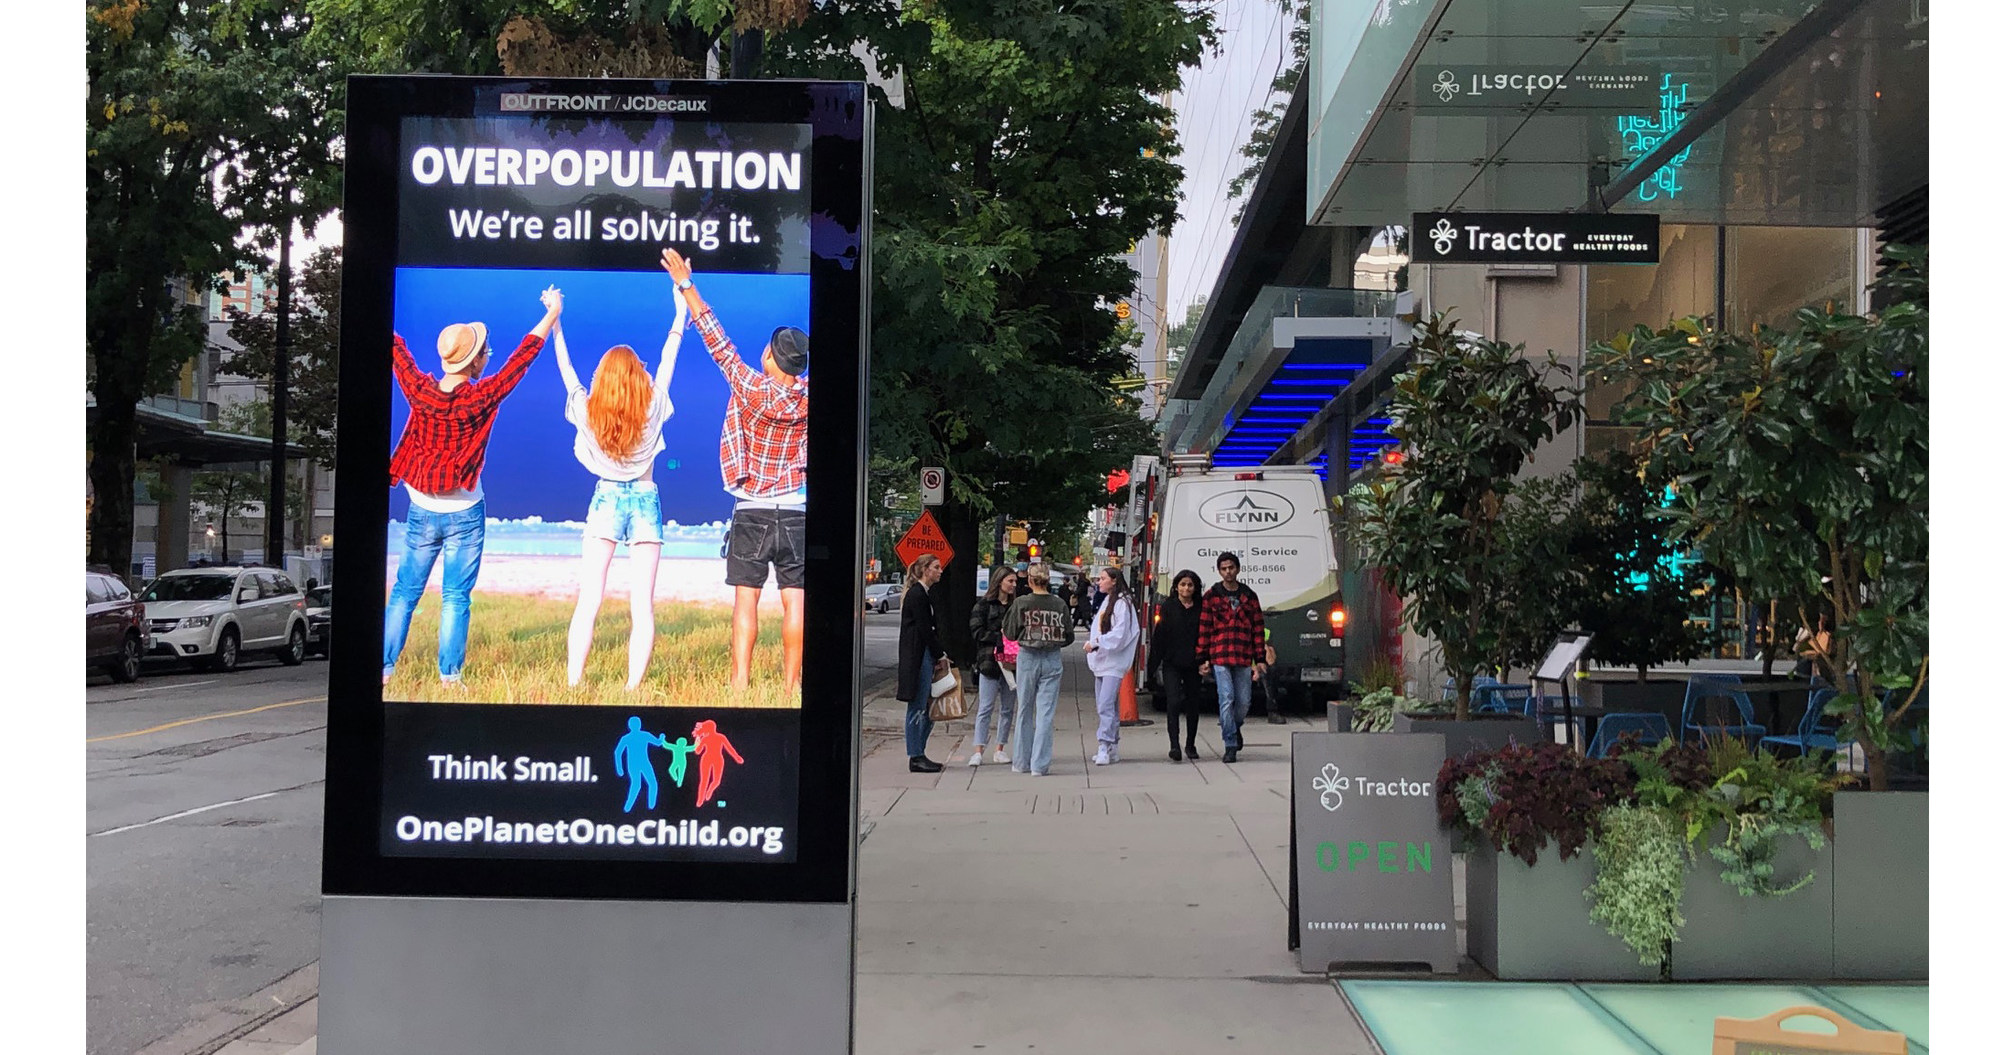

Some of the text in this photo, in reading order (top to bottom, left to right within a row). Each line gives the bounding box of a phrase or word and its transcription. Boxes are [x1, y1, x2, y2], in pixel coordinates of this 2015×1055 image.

[505, 95, 611, 110] OUTFRONT
[622, 96, 707, 111] JCDecaux
[411, 147, 801, 190] OVERPOPULATION
[553, 210, 591, 240] all
[601, 212, 720, 251] solving
[729, 214, 761, 244] it.
[1464, 226, 1566, 250] Tractor
[1215, 512, 1279, 523] FLYNN
[922, 525, 932, 535] BE
[907, 538, 945, 550] PREPARED
[1251, 547, 1298, 556] Service
[428, 755, 598, 783] Think Small.
[1355, 777, 1431, 796] Tractor
[396, 816, 783, 853] OnePlanetOneChild.org
[1316, 841, 1432, 873] OPEN
[1307, 922, 1446, 930] EVERYDAY HEALTHY FOODS
